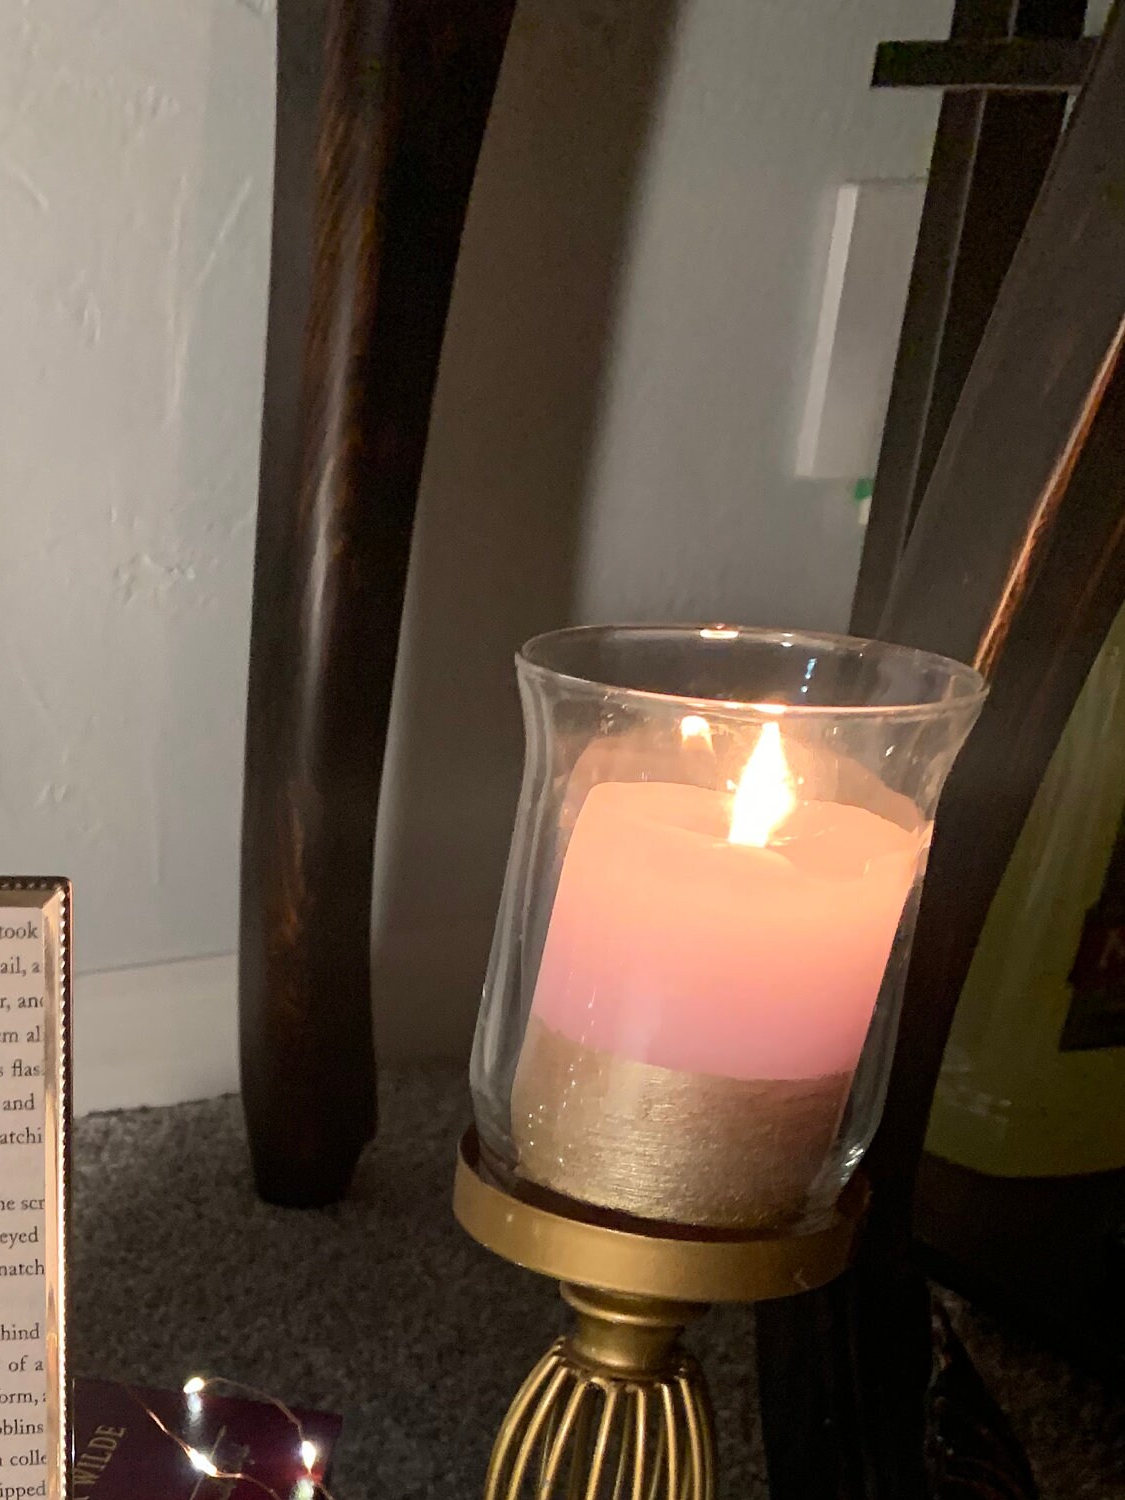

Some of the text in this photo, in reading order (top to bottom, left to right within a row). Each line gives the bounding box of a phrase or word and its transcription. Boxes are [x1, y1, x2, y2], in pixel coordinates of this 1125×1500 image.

[3, 1093, 36, 1111] and
[0, 1227, 38, 1248] eyed
[8, 1355, 28, 1372] of
[35, 1361, 44, 1372] a
[73, 1425, 127, 1486] WILDE
